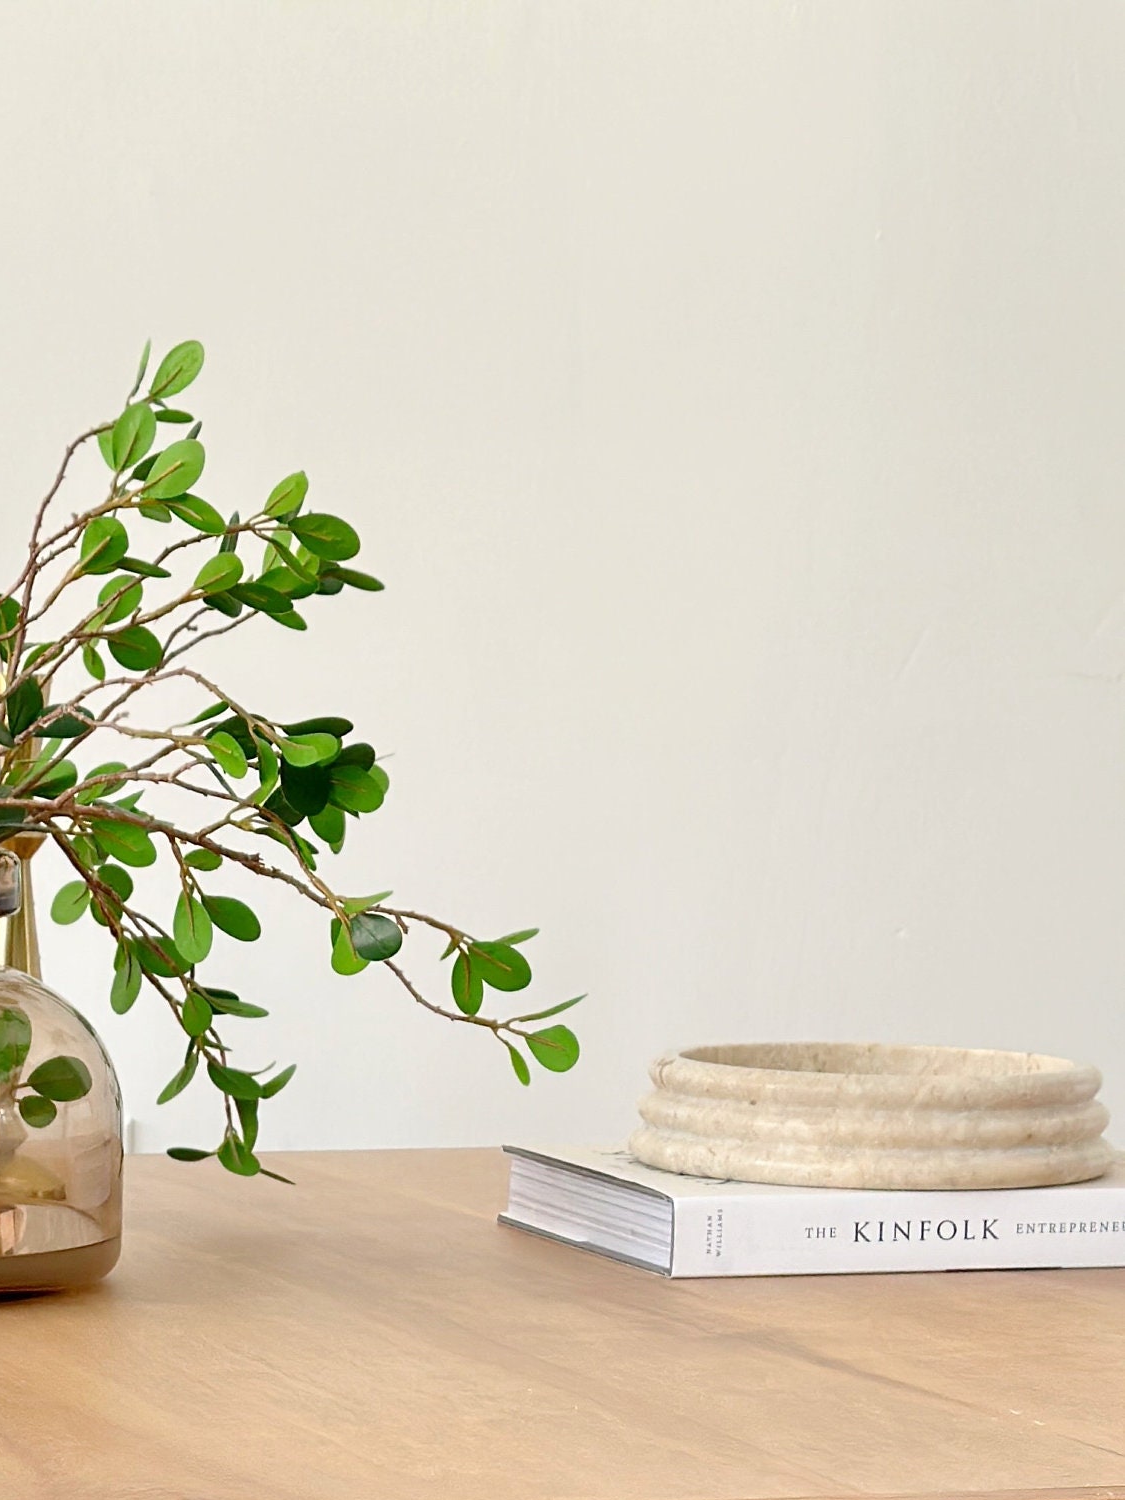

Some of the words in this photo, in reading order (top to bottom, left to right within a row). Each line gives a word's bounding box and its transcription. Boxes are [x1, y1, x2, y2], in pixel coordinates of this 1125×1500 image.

[715, 1208, 724, 1257] WILLIAMS
[805, 1227, 837, 1239] THE
[853, 1218, 1000, 1243] KINFOLK
